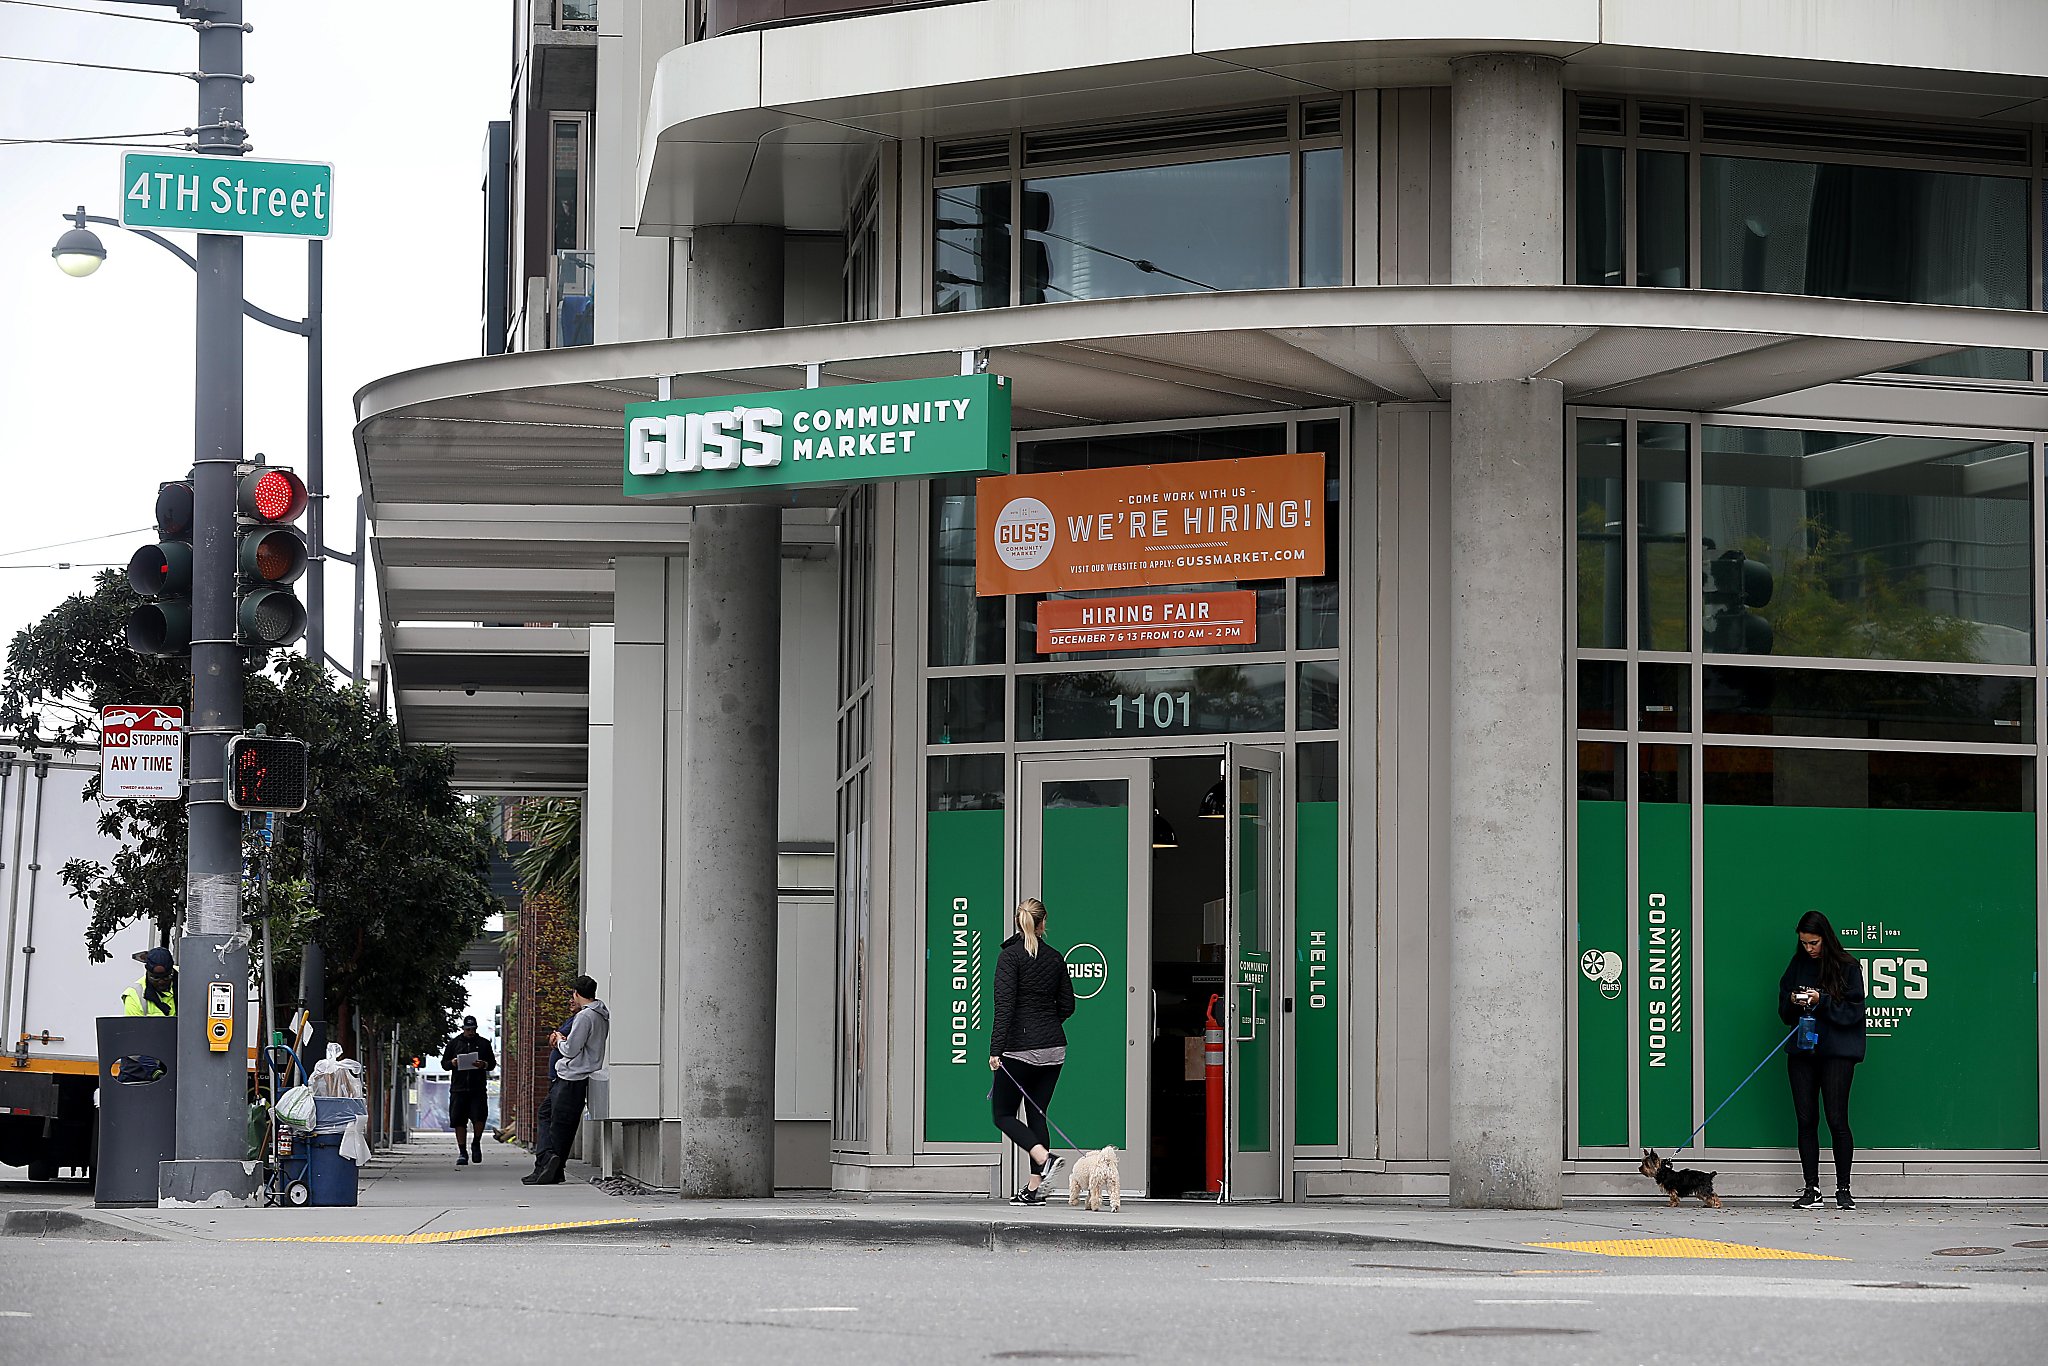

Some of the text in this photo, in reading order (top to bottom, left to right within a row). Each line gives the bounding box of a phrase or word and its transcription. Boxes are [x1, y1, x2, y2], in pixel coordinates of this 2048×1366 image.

[128, 172, 326, 220] 4TH Street
[792, 398, 971, 433] COMMUNITY
[628, 405, 784, 476] GUS'S
[792, 430, 916, 460] MARKET
[1128, 487, 1246, 505] COME WORK WITH US
[1000, 522, 1049, 544] GUS'S
[1067, 500, 1312, 543] WE'RE HIRING!
[1070, 550, 1306, 574] VISIT OUR WEBSITE TO APPLY: GUSSMARKET.COM
[1082, 602, 1210, 625] HIRING FAIR
[1051, 634, 1106, 645] DECEMBER
[1109, 633, 1115, 642] 7
[1118, 633, 1124, 642] &
[1127, 632, 1138, 641] 13
[1140, 631, 1170, 640] FROM
[1173, 630, 1184, 639] 10
[1188, 629, 1204, 638] AM
[1216, 628, 1222, 637] 2
[1225, 627, 1240, 636] PM
[1109, 692, 1190, 729] 1101
[105, 732, 179, 746] NO STOPPING
[111, 756, 172, 771] ANY TIME
[952, 897, 968, 1064] COMING SOON
[1067, 962, 1103, 978] GUS'S
[1310, 931, 1326, 1008] HELLO
[1649, 893, 1666, 1067] COMING SOON
[1860, 957, 1928, 999] S'S
[1866, 1019, 1900, 1028] RKET
